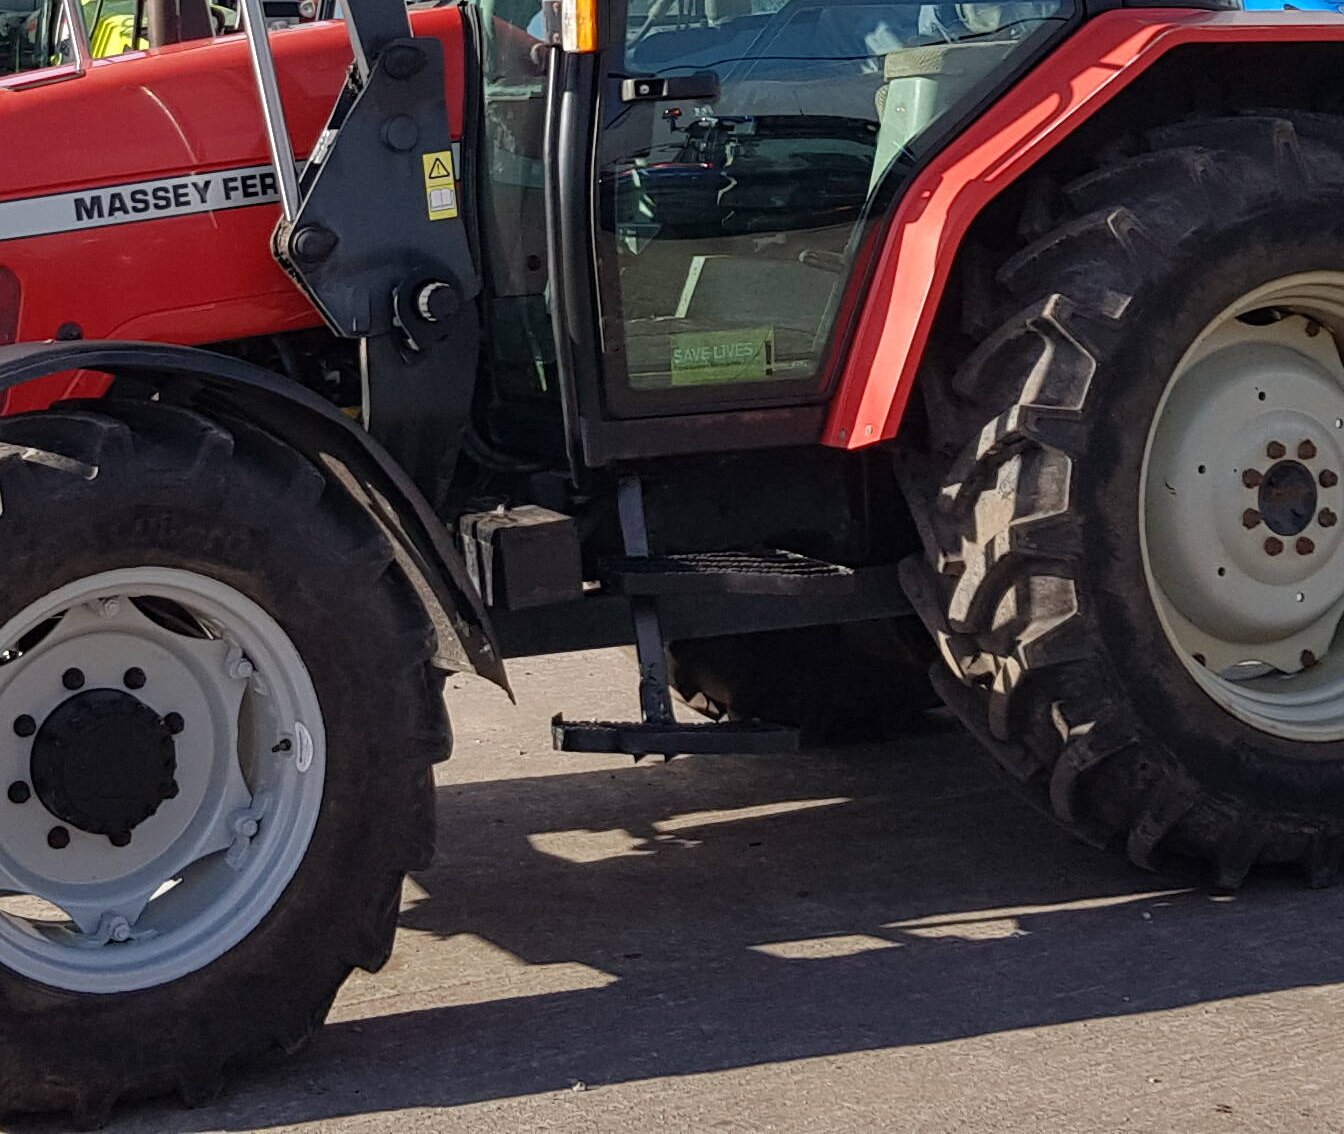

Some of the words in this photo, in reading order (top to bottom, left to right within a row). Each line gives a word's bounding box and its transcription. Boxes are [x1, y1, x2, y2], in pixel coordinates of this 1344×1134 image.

[73, 180, 211, 222] MASSEY
[222, 172, 279, 201] FER
[673, 346, 711, 364] SAVE
